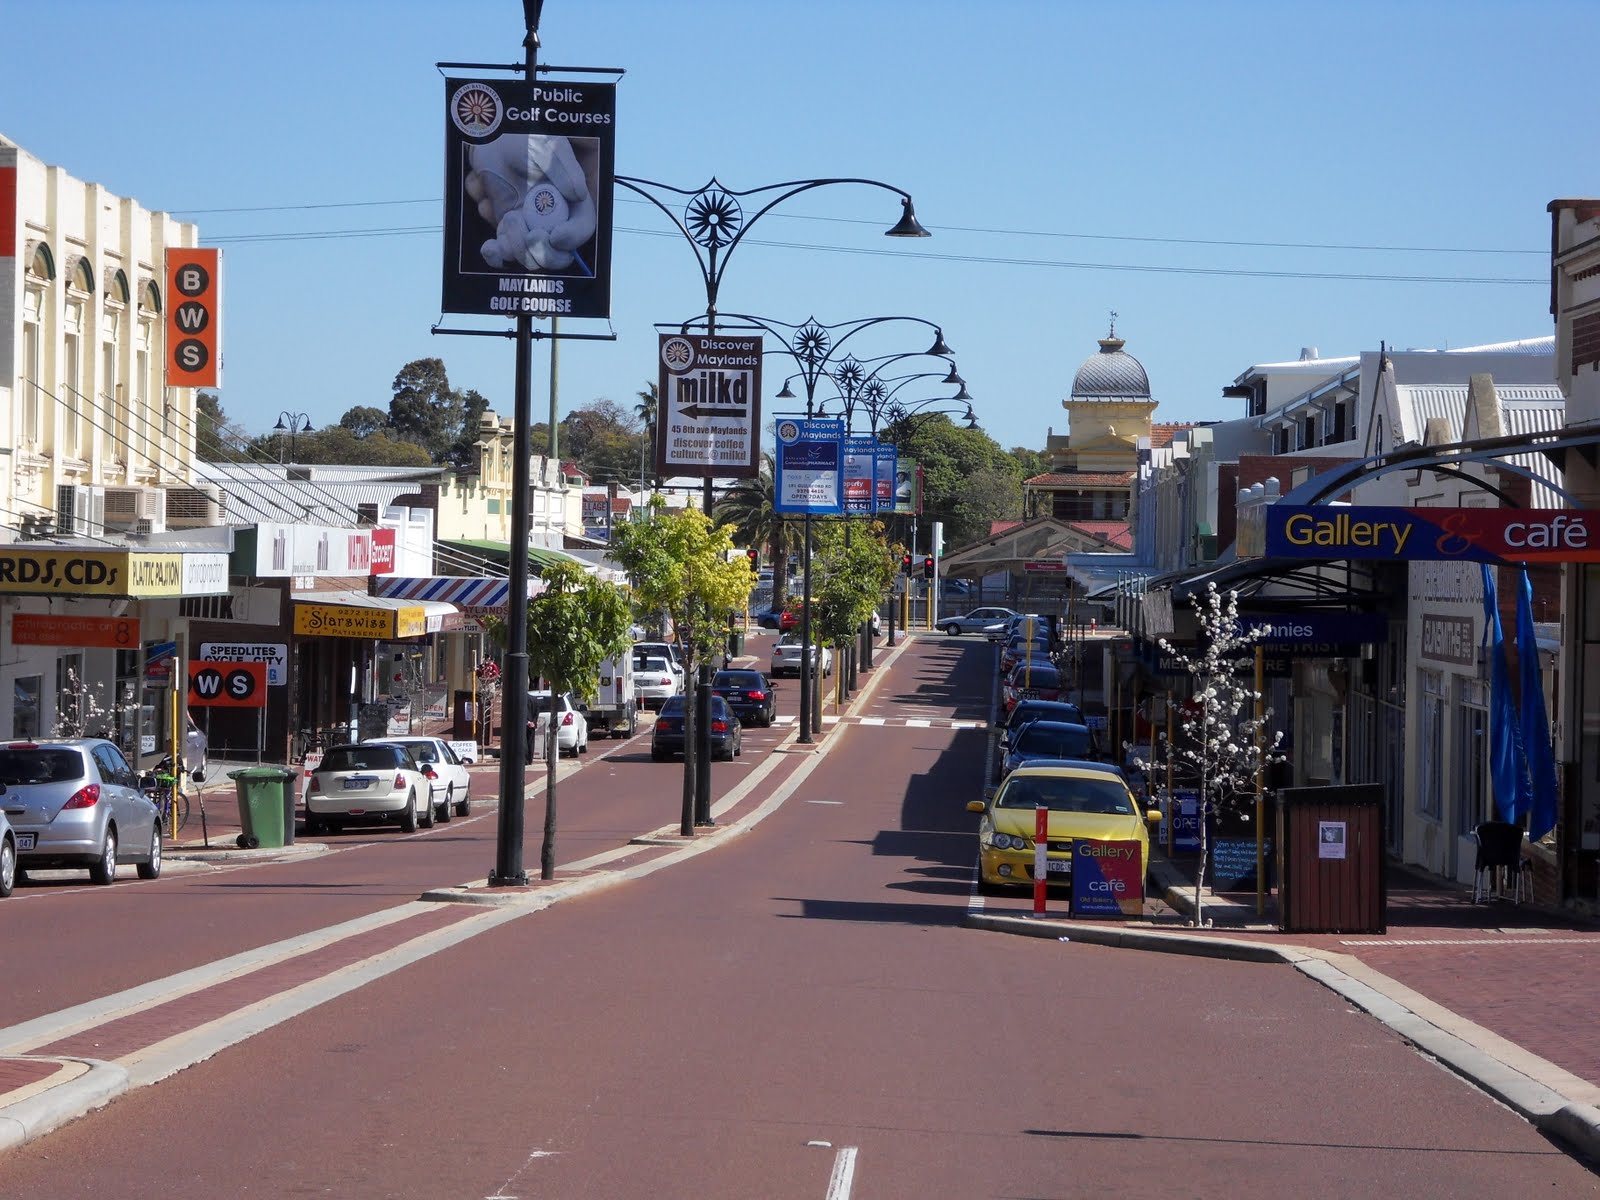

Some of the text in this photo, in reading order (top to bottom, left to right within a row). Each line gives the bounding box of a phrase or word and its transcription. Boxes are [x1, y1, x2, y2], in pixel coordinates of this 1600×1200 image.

[533, 88, 583, 104] Public
[506, 107, 610, 124] Golf Courses
[499, 278, 564, 294] MAYLANDS
[490, 296, 571, 312] GOLF COURSE
[180, 270, 204, 366] BWS
[700, 340, 754, 350] Discover
[697, 354, 758, 366] Maylands
[676, 372, 748, 404] milkd
[672, 425, 682, 433] 45
[683, 425, 694, 434] 8th
[711, 426, 748, 435] Maylands
[674, 438, 744, 449] discover coffee
[720, 450, 746, 460] milkd
[584, 502, 606, 511] LLAGE
[1285, 514, 1412, 553] Gallery
[1504, 516, 1588, 548] café
[463, 606, 508, 615] AYLANDS
[1248, 622, 1313, 637] Vinnies
[210, 646, 276, 656] SPEEDLITES
[198, 675, 248, 694] WS
[1080, 844, 1134, 860] Gallery
[1088, 880, 1126, 892] café
